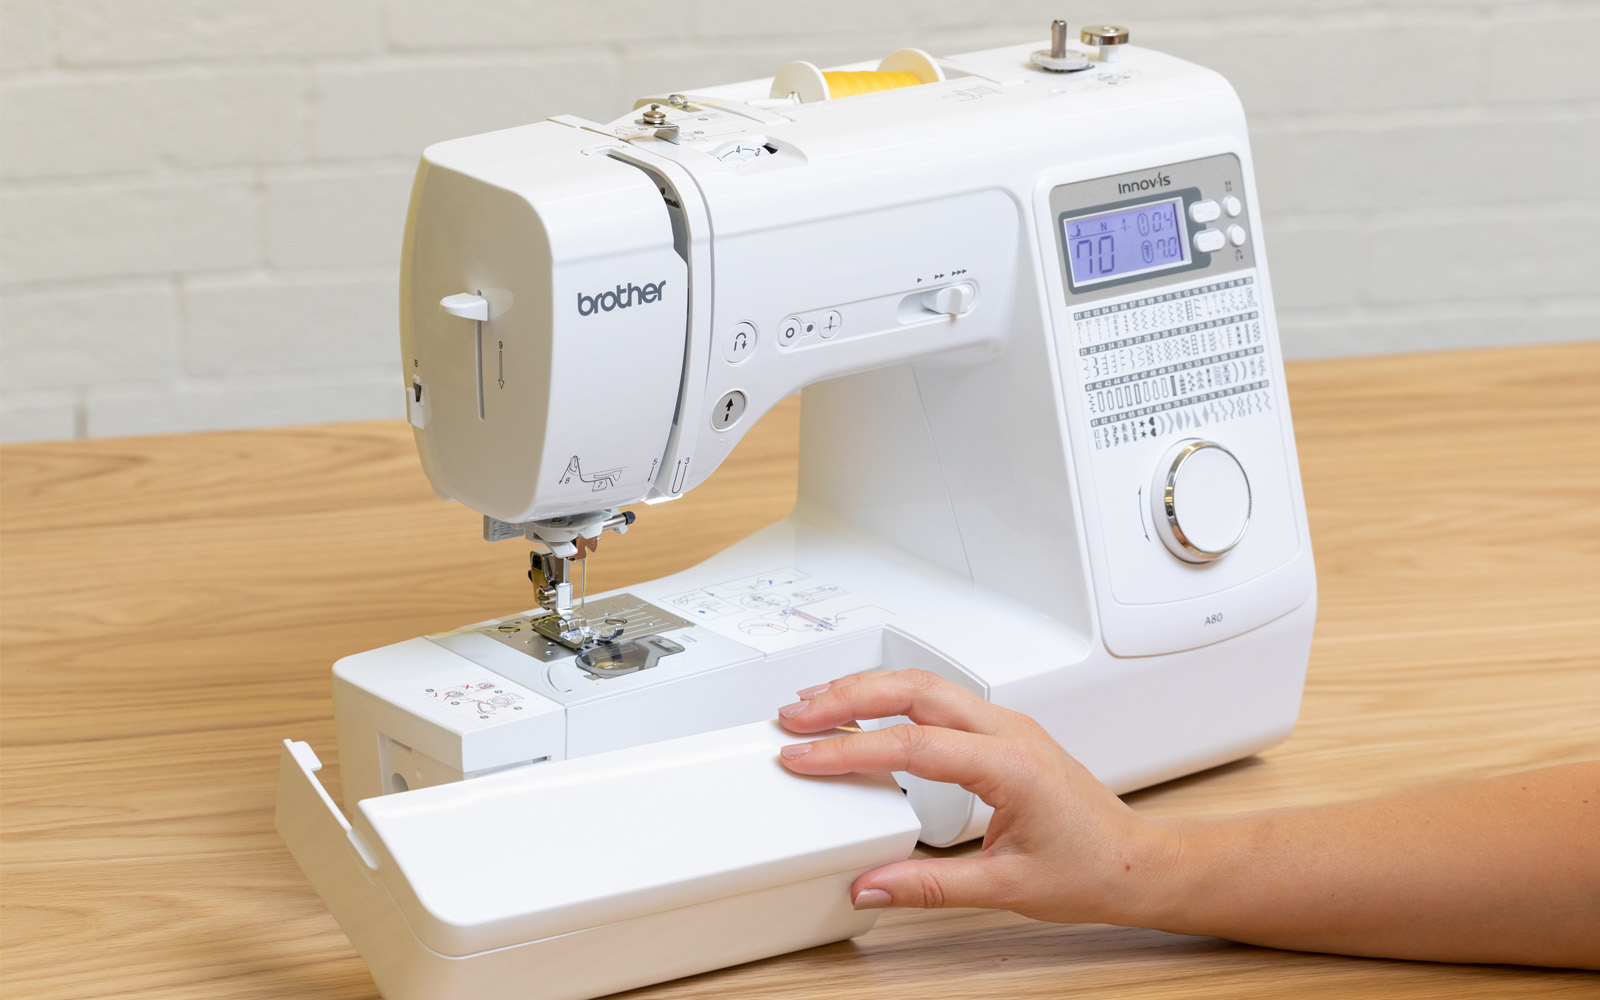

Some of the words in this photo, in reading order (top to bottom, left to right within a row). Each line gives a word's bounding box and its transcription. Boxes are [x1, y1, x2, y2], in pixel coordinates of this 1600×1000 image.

[1076, 235, 1115, 275] 70
[577, 280, 666, 316] brother
[1205, 612, 1223, 626] A80
